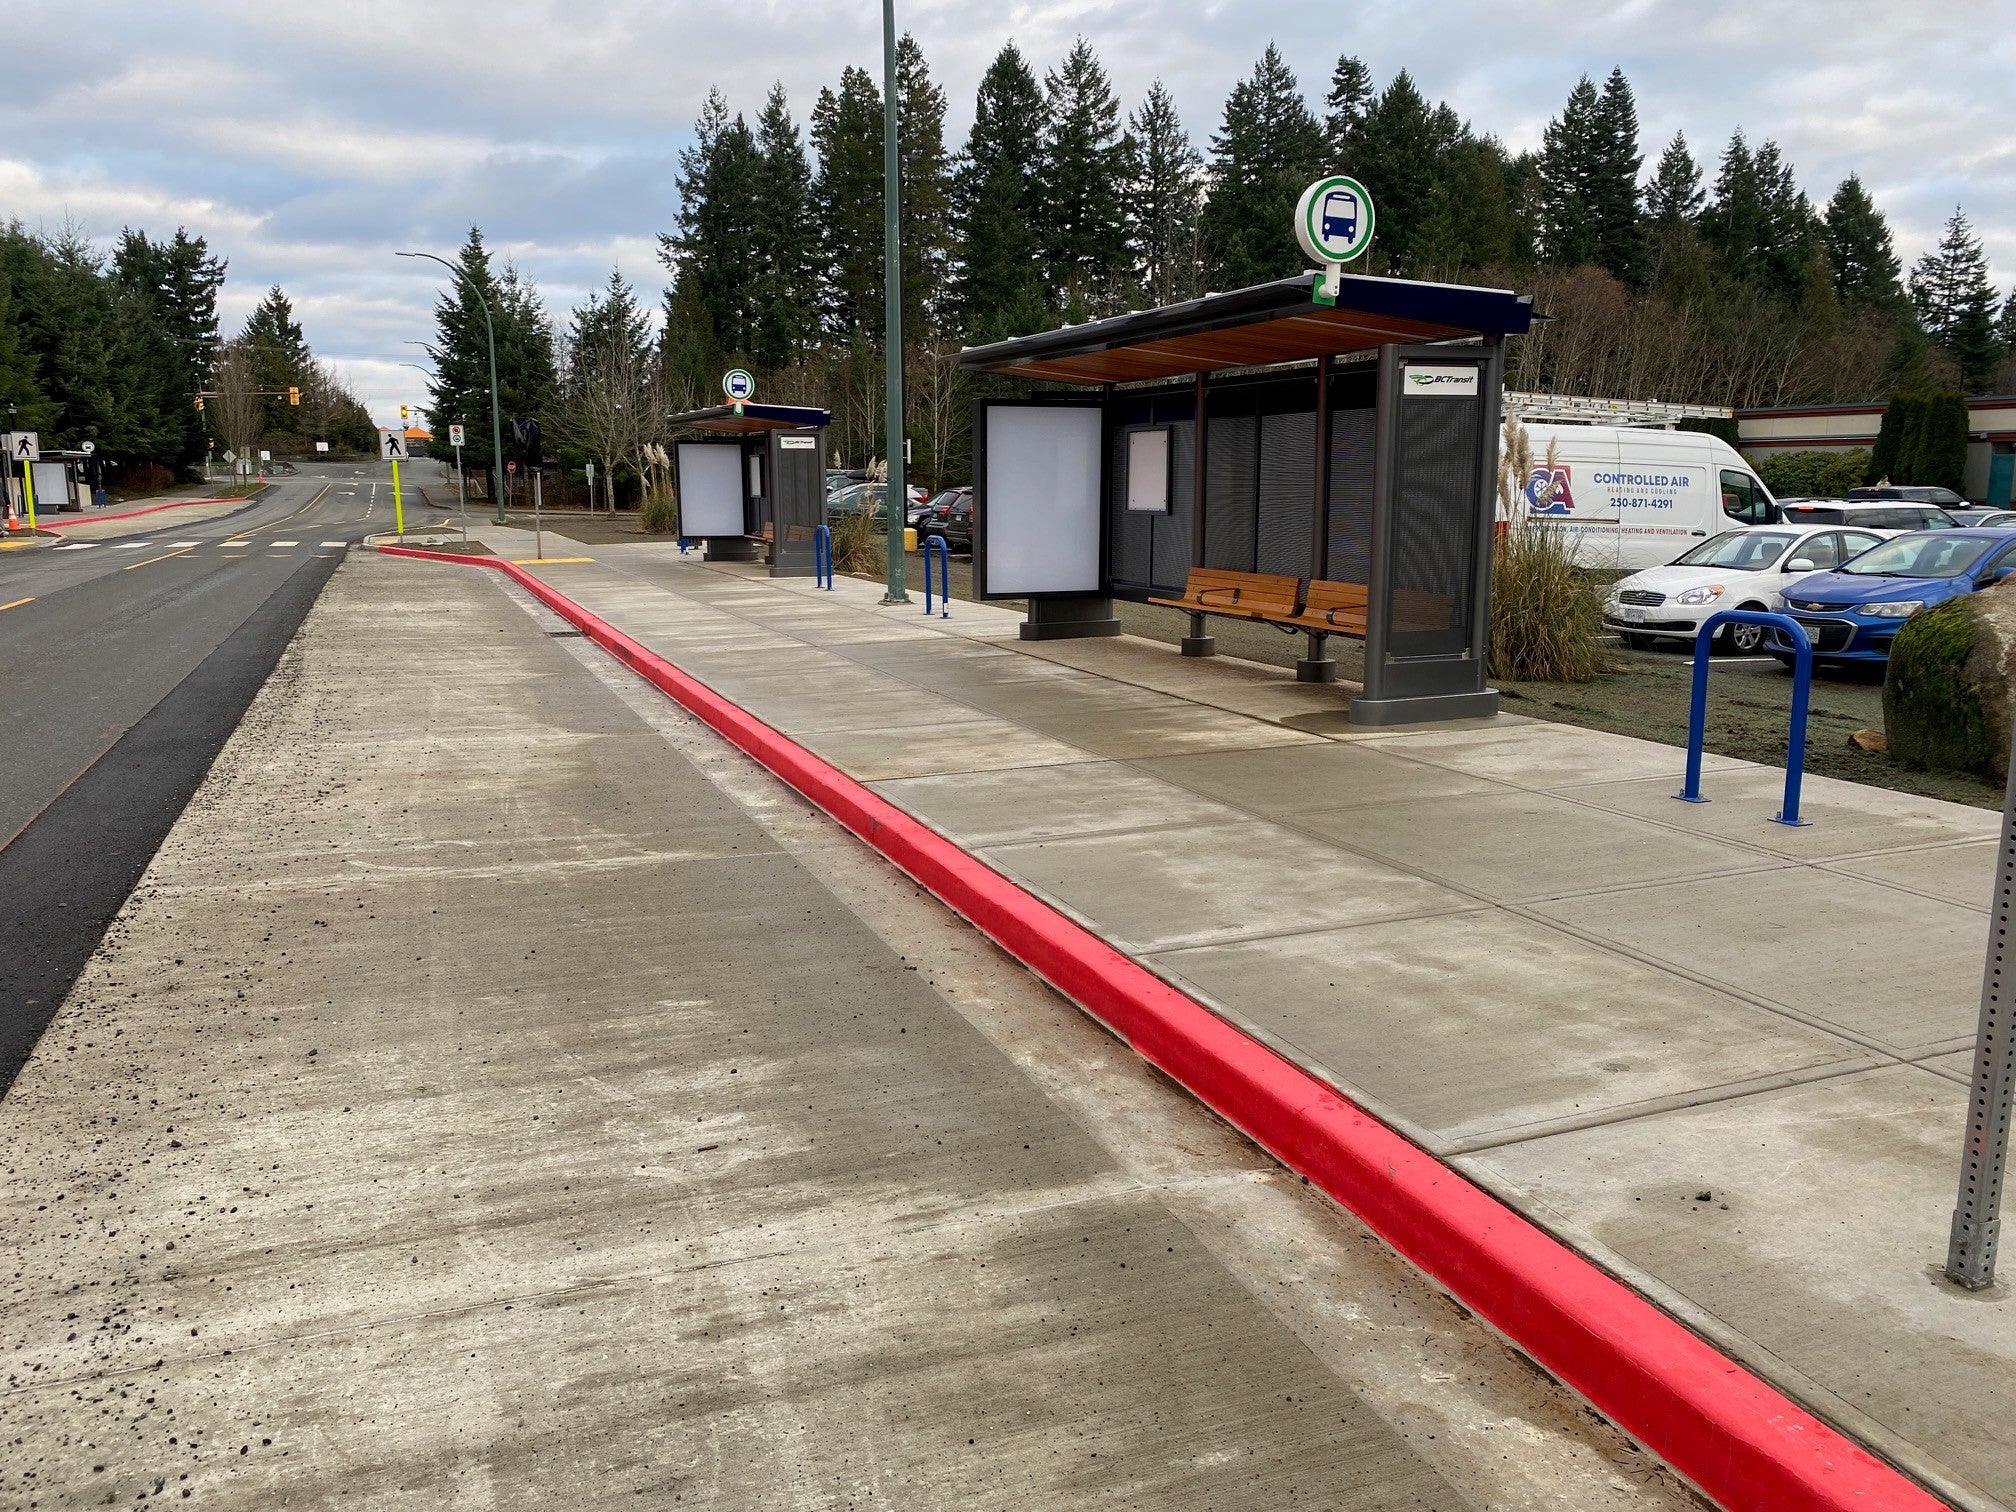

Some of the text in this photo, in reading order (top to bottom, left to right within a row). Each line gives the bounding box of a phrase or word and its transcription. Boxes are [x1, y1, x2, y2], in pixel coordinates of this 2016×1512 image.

[1593, 473, 1690, 487] CONTROLLED AIR
[1607, 486, 1634, 494] HEATING
[1636, 487, 1648, 495] AND
[1610, 497, 1673, 509] 250-871-4291
[1656, 528, 1688, 536] VENTILATION
